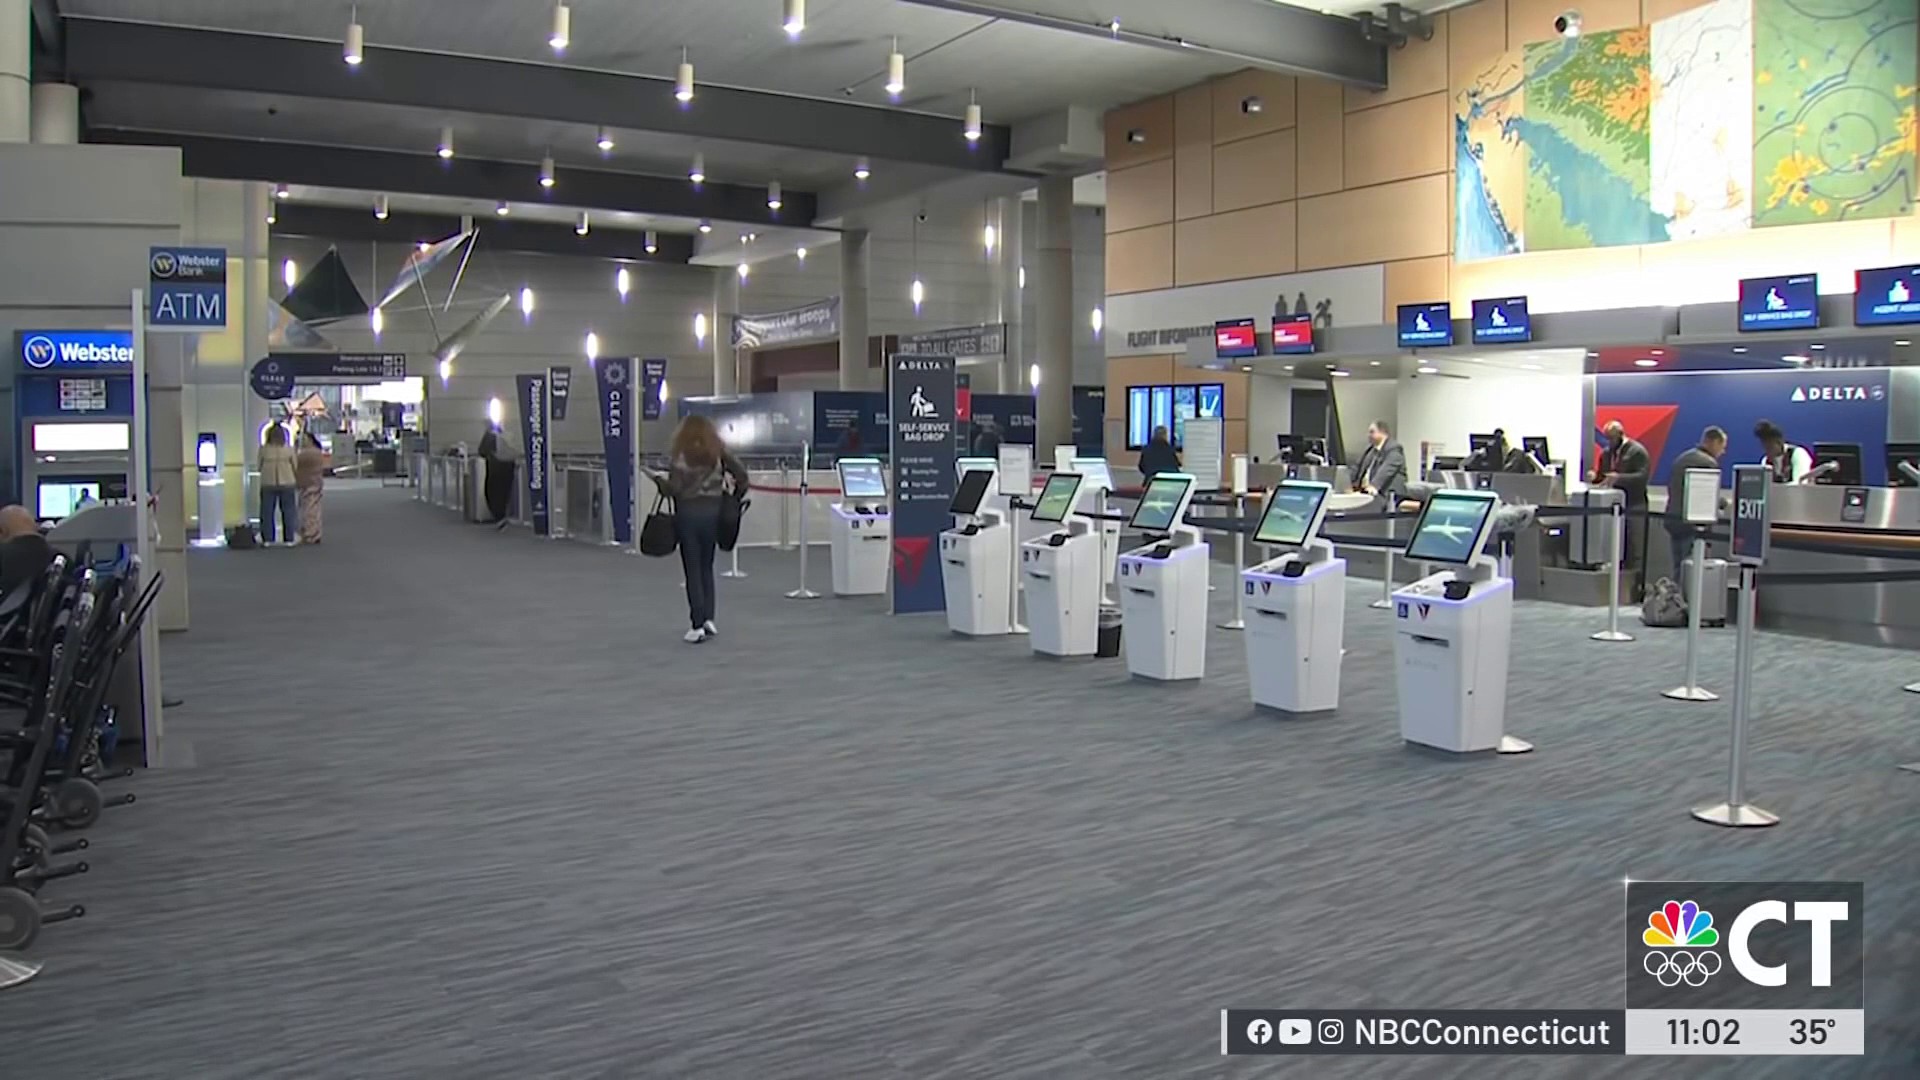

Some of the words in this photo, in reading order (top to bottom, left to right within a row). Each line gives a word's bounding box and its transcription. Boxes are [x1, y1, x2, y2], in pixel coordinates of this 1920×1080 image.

[178, 255, 220, 267] Webster
[178, 267, 204, 277] Bank
[156, 293, 219, 319] ATM
[947, 337, 977, 354] GATES
[1127, 330, 1157, 347] FLIGHT
[59, 342, 134, 362] Webster
[908, 361, 940, 370] DELTA
[1808, 386, 1866, 400] DELTA
[529, 379, 543, 433] Passenger
[609, 391, 623, 438] CLEAR
[899, 422, 950, 432] SELF-SERVICE
[904, 432, 922, 441] BAG
[923, 432, 945, 441] DROP
[530, 436, 543, 489] Screening
[1738, 499, 1765, 520] EXIT
